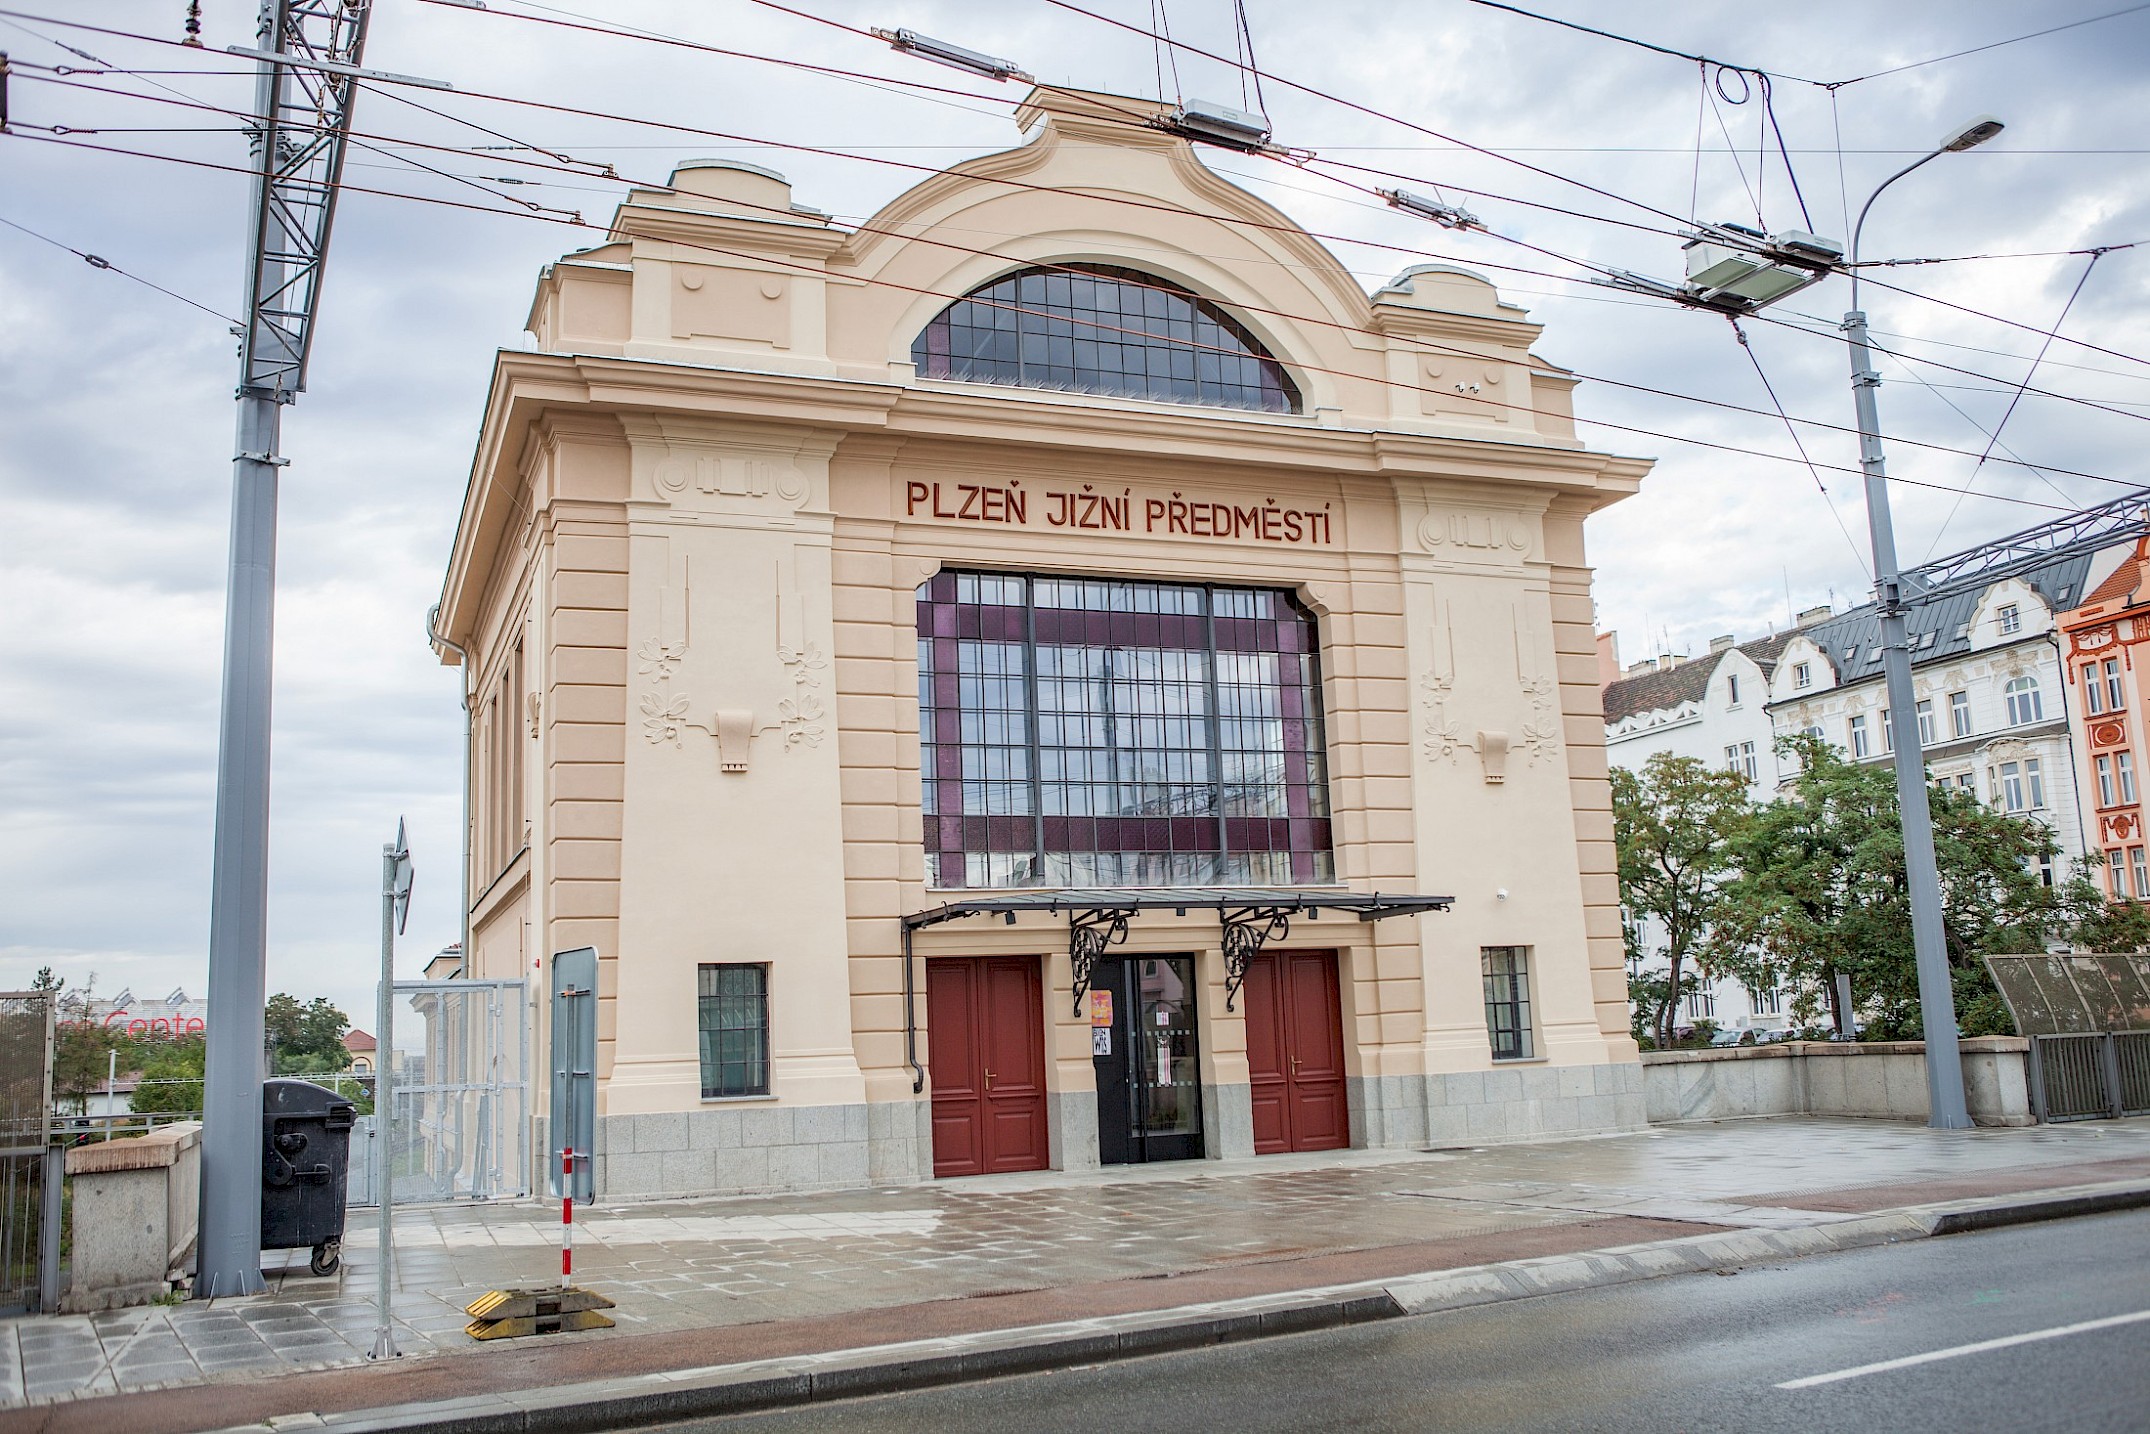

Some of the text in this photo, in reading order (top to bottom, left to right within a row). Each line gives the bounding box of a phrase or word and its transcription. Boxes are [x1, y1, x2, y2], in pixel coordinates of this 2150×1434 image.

[907, 480, 1331, 544] PLZEŇ JIŽNÍ PŘEDMĚSTÍ
[104, 1010, 205, 1040] Cente
